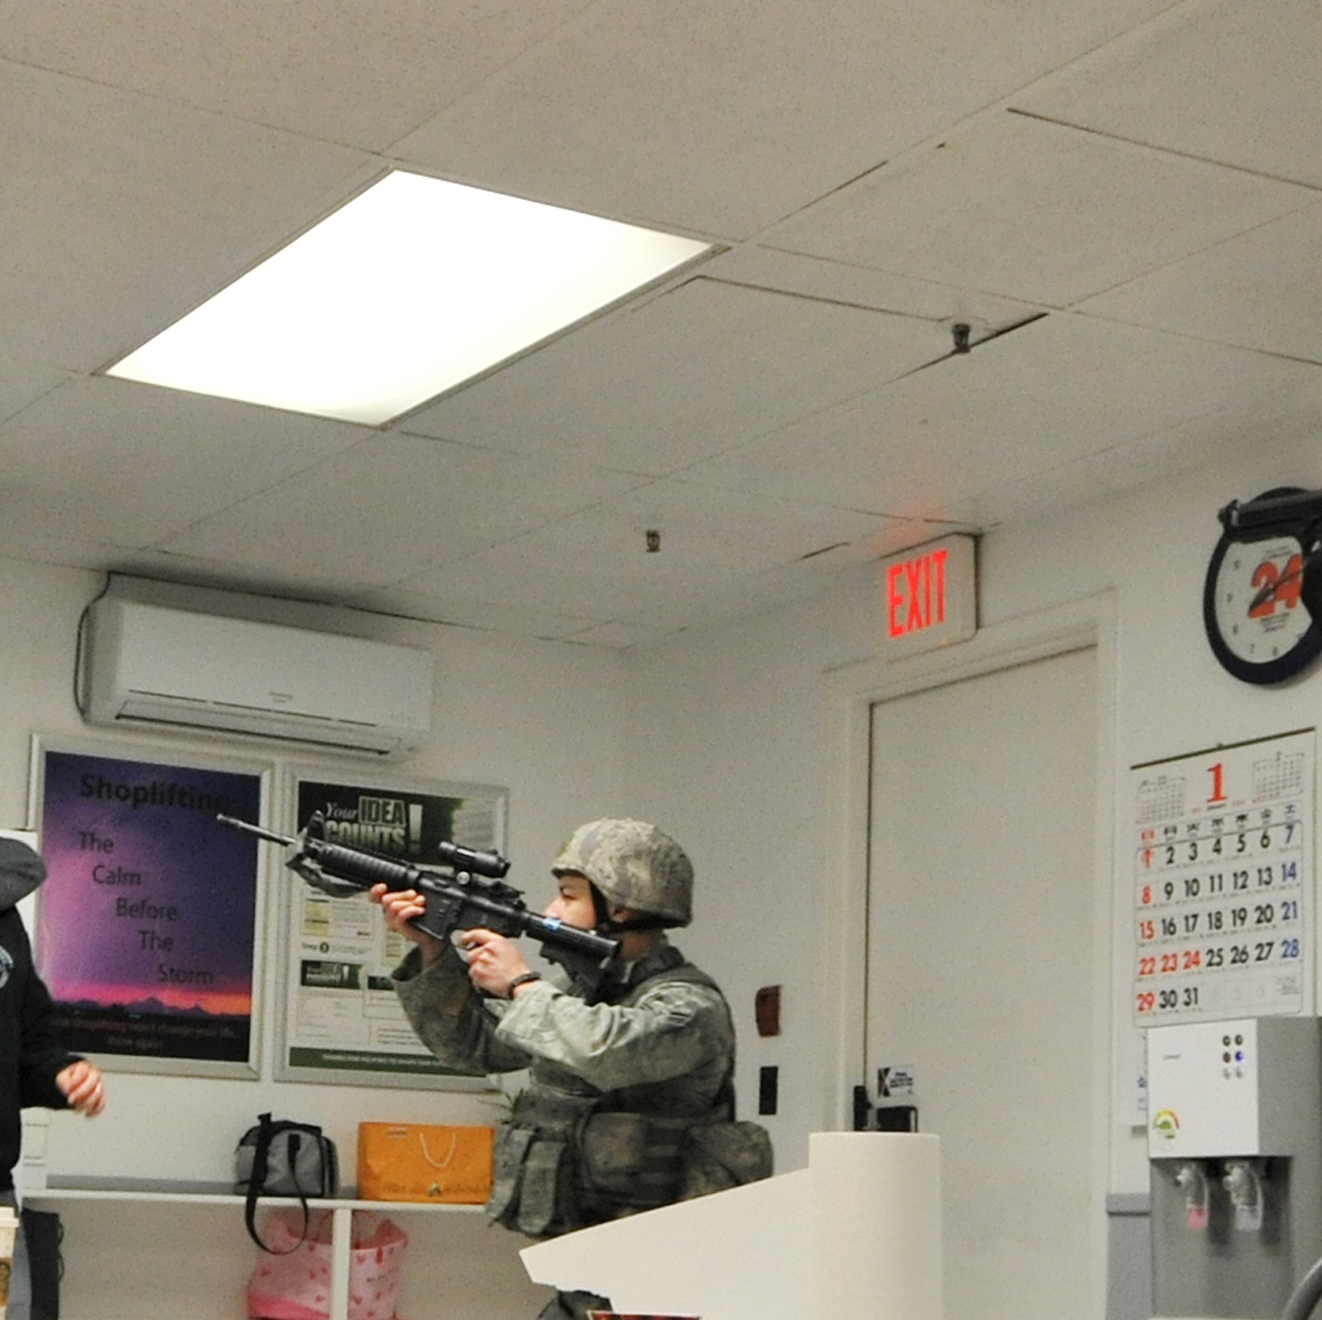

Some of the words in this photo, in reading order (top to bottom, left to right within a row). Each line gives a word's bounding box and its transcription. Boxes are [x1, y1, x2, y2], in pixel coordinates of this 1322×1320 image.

[888, 549, 947, 638] EXIT
[1247, 553, 1303, 619] 24
[1207, 763, 1228, 802] 1
[325, 801, 358, 820] Your
[359, 796, 405, 826] IDEA
[78, 831, 114, 854] The
[1143, 847, 1154, 868] 1
[1166, 846, 1175, 865] 2
[1188, 842, 1198, 861] 3
[1212, 838, 1222, 855] 4
[1237, 833, 1246, 853] 5
[1260, 829, 1270, 849] 6
[1286, 823, 1295, 844] 7
[92, 865, 142, 886] Calm
[1142, 886, 1152, 904] 8
[1164, 882, 1174, 900] 9
[1184, 878, 1200, 897] 10
[1209, 873, 1223, 893] 11
[1233, 870, 1249, 890] 12
[1257, 867, 1273, 886] 13
[1281, 862, 1297, 882] 14
[116, 897, 177, 921] Before
[1140, 921, 1155, 940] 15
[1161, 917, 1177, 936] 16
[1184, 914, 1200, 933] 17
[1207, 911, 1223, 930] 18
[1232, 907, 1248, 927] 19
[1255, 903, 1275, 924] 20
[1281, 901, 1298, 921] 21
[138, 930, 174, 952] The
[1138, 957, 1156, 976] 22
[1161, 953, 1178, 972] 23
[1183, 950, 1201, 969] 24
[1206, 948, 1224, 967] 25
[1230, 945, 1249, 964] 26
[1255, 941, 1275, 961] 27
[1281, 938, 1299, 958] 28
[158, 963, 216, 985] Storm
[1136, 992, 1155, 1012] 29
[1159, 989, 1177, 1009] 30
[1183, 987, 1199, 1007] 31
